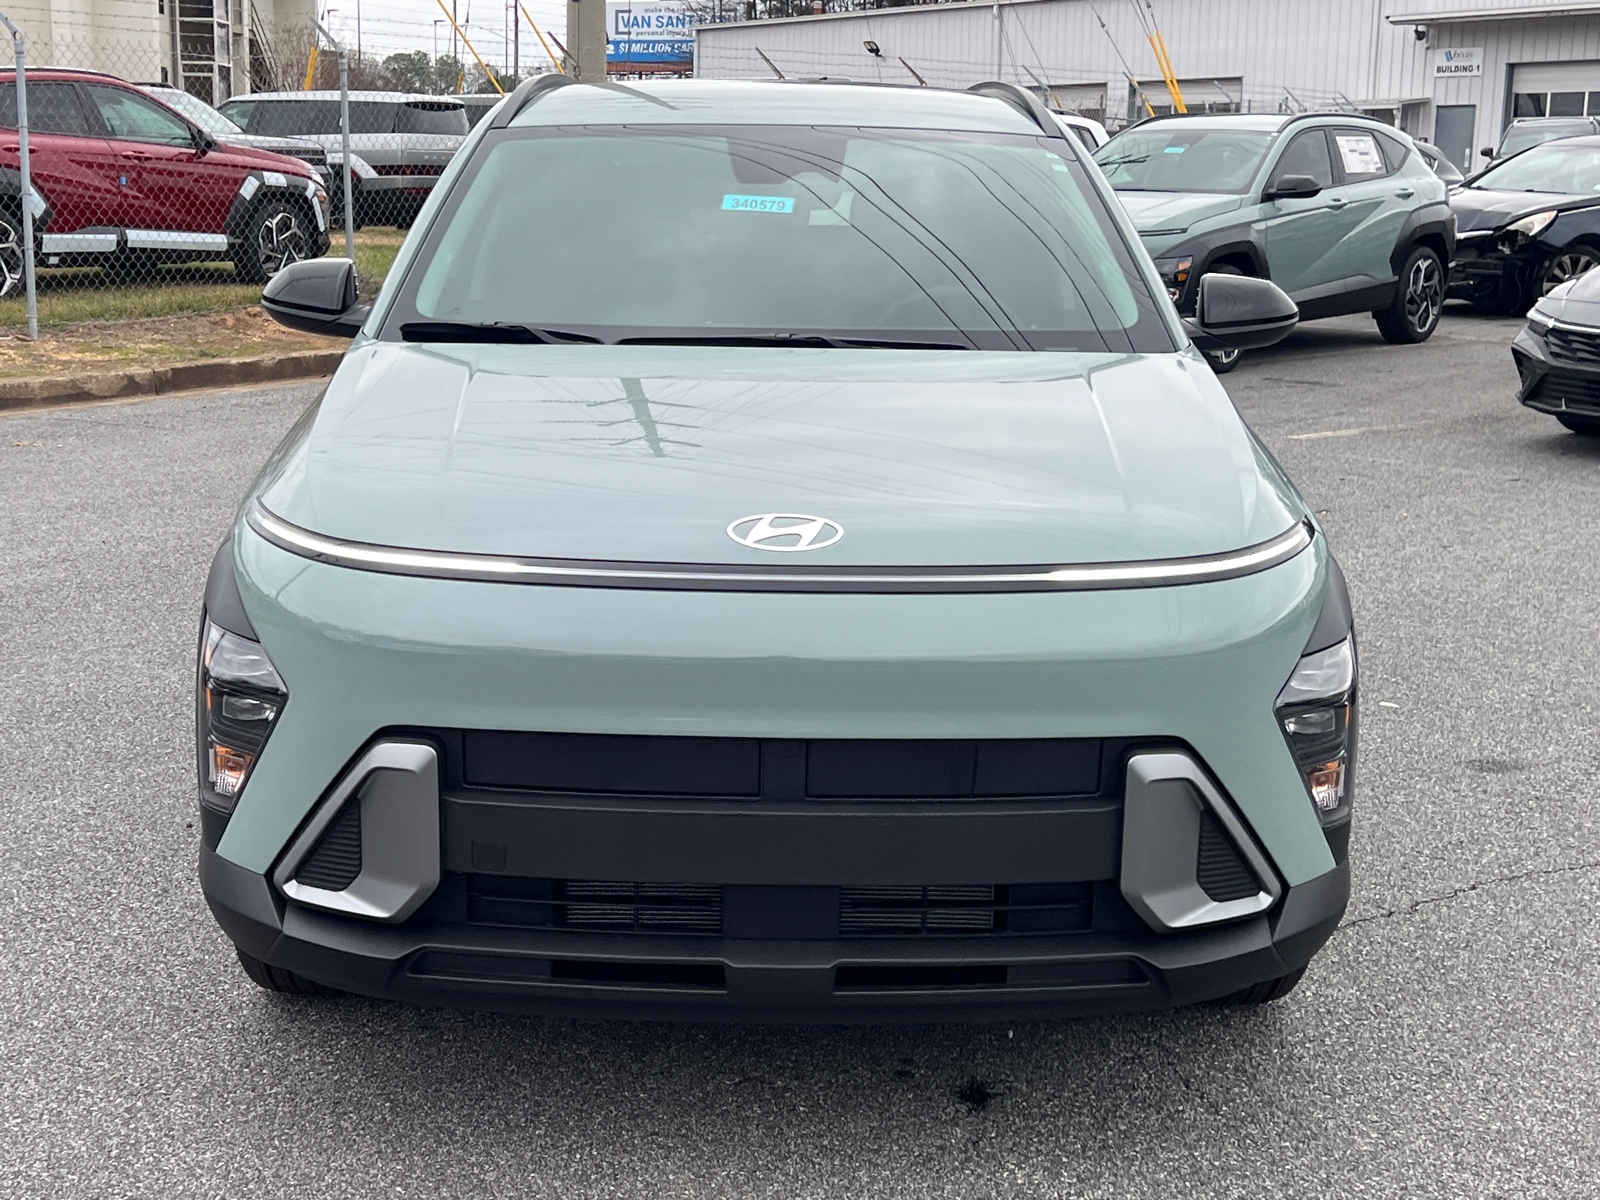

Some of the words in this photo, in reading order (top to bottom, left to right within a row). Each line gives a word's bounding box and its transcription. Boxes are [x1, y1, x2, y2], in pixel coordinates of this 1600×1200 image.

[664, 6, 676, 14] the
[621, 15, 651, 28] VAN
[655, 15, 695, 29] SANT
[631, 42, 672, 53] MILLION
[1436, 64, 1474, 73] BUILDING
[731, 198, 786, 211] 340579
